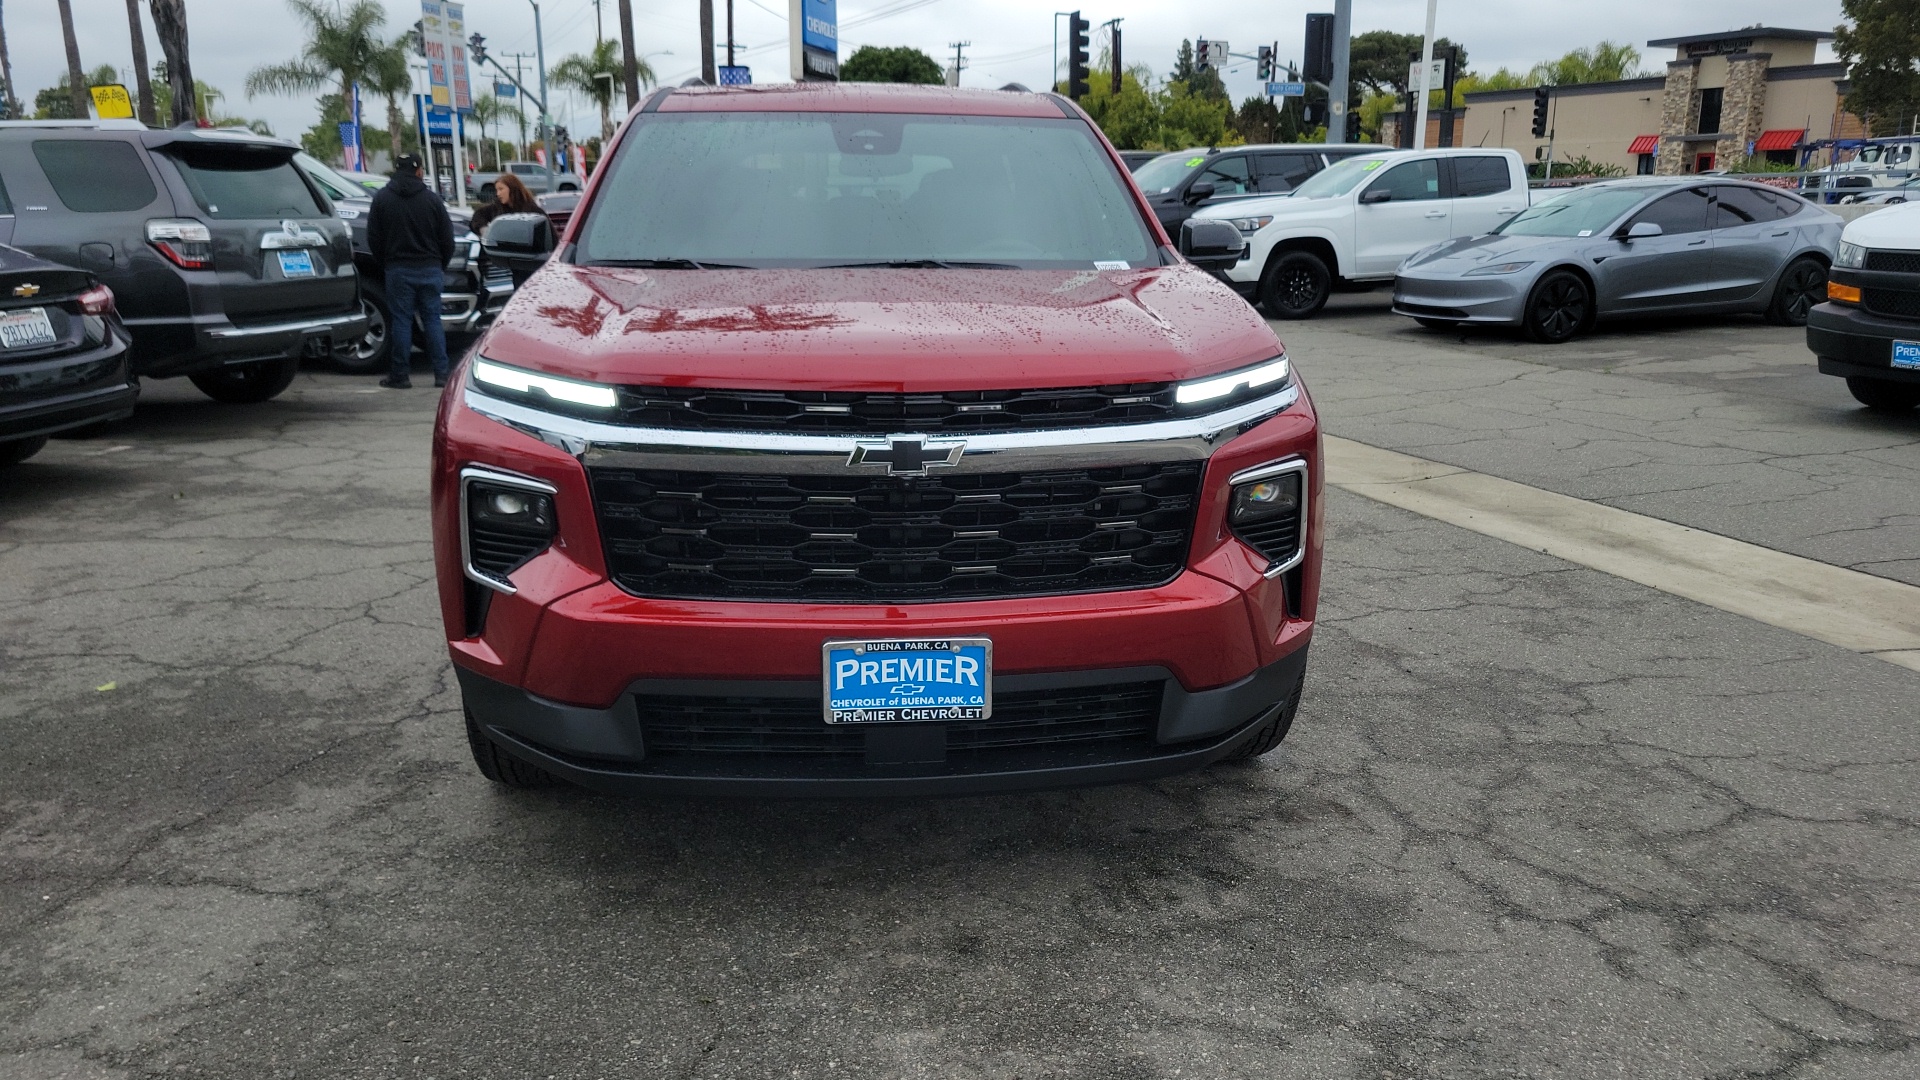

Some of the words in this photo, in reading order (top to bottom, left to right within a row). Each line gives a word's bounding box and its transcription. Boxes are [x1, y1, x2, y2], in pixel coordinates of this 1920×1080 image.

[867, 643, 901, 651] BUENA
[836, 655, 979, 690] PREMIER
[831, 698, 886, 708] CHEVROLET
[889, 698, 899, 706] of
[901, 697, 935, 706] BUENA
[938, 696, 967, 705] PARK,
[970, 695, 984, 704] CA
[833, 710, 896, 722] PREMIER
[901, 708, 982, 720] CHEVROLET
